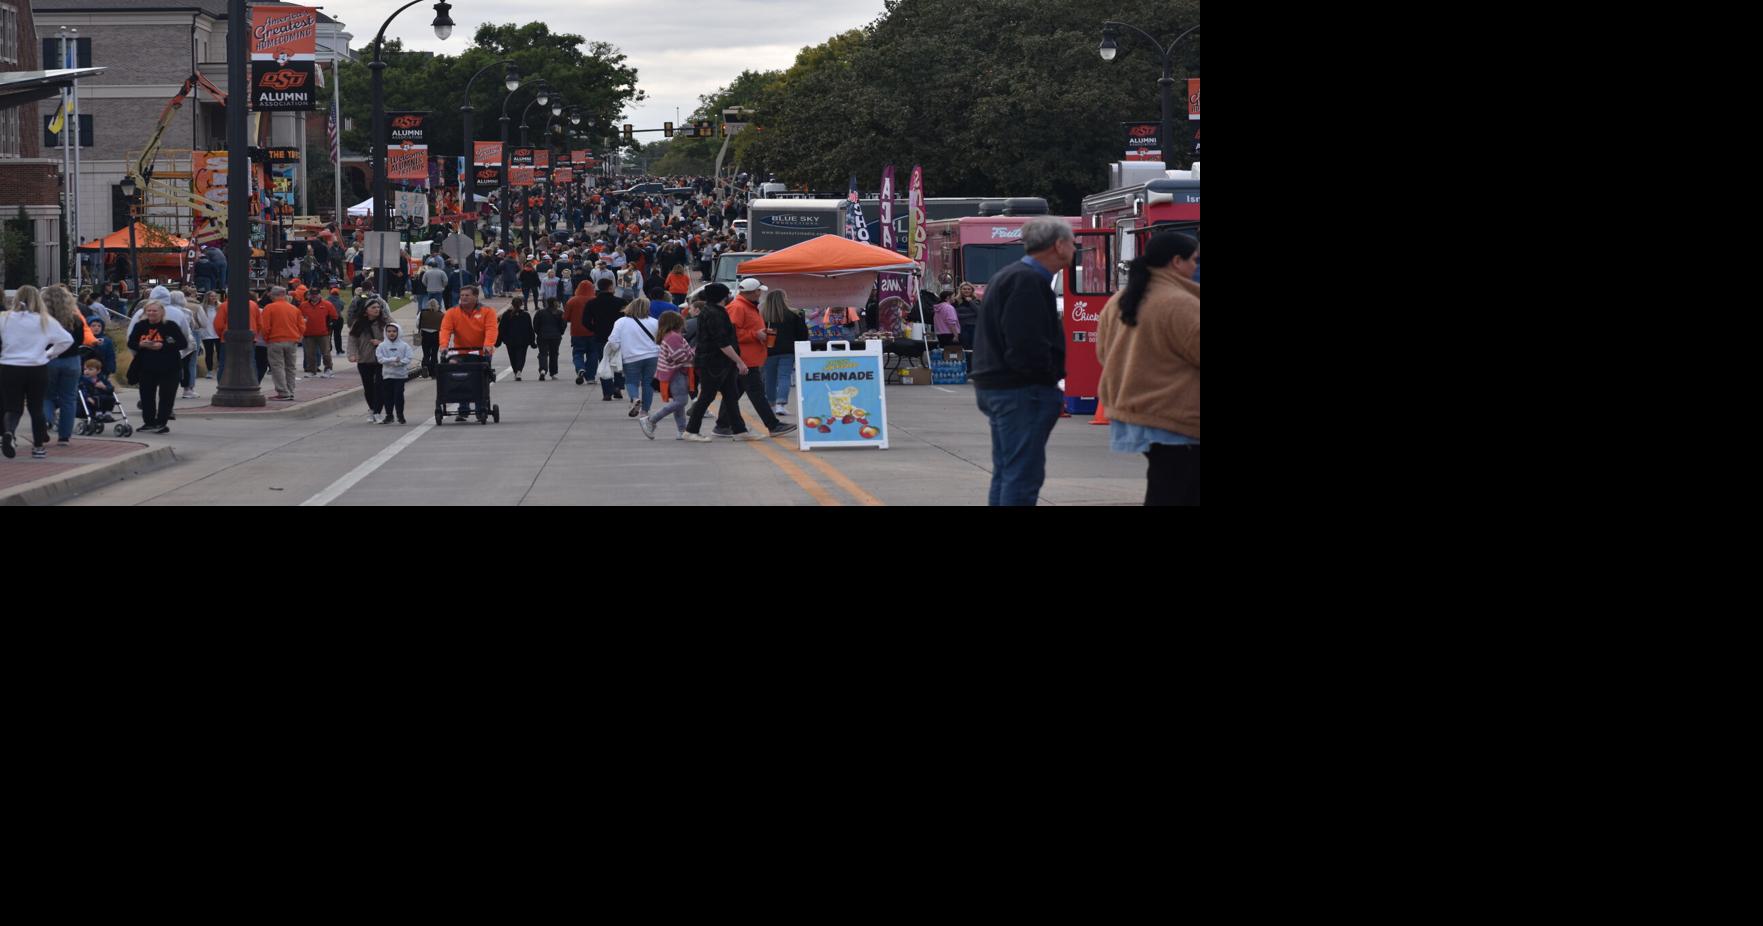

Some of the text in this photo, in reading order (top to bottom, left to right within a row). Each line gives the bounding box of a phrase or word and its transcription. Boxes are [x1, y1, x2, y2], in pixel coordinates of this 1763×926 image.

[255, 16, 315, 41] Greatest
[257, 28, 312, 51] HOMECOMING
[259, 69, 308, 91] OSU
[259, 92, 308, 102] ALUMNI
[268, 151, 285, 159] THE
[1072, 303, 1100, 321] Chick
[805, 370, 874, 382] LEMONADE
